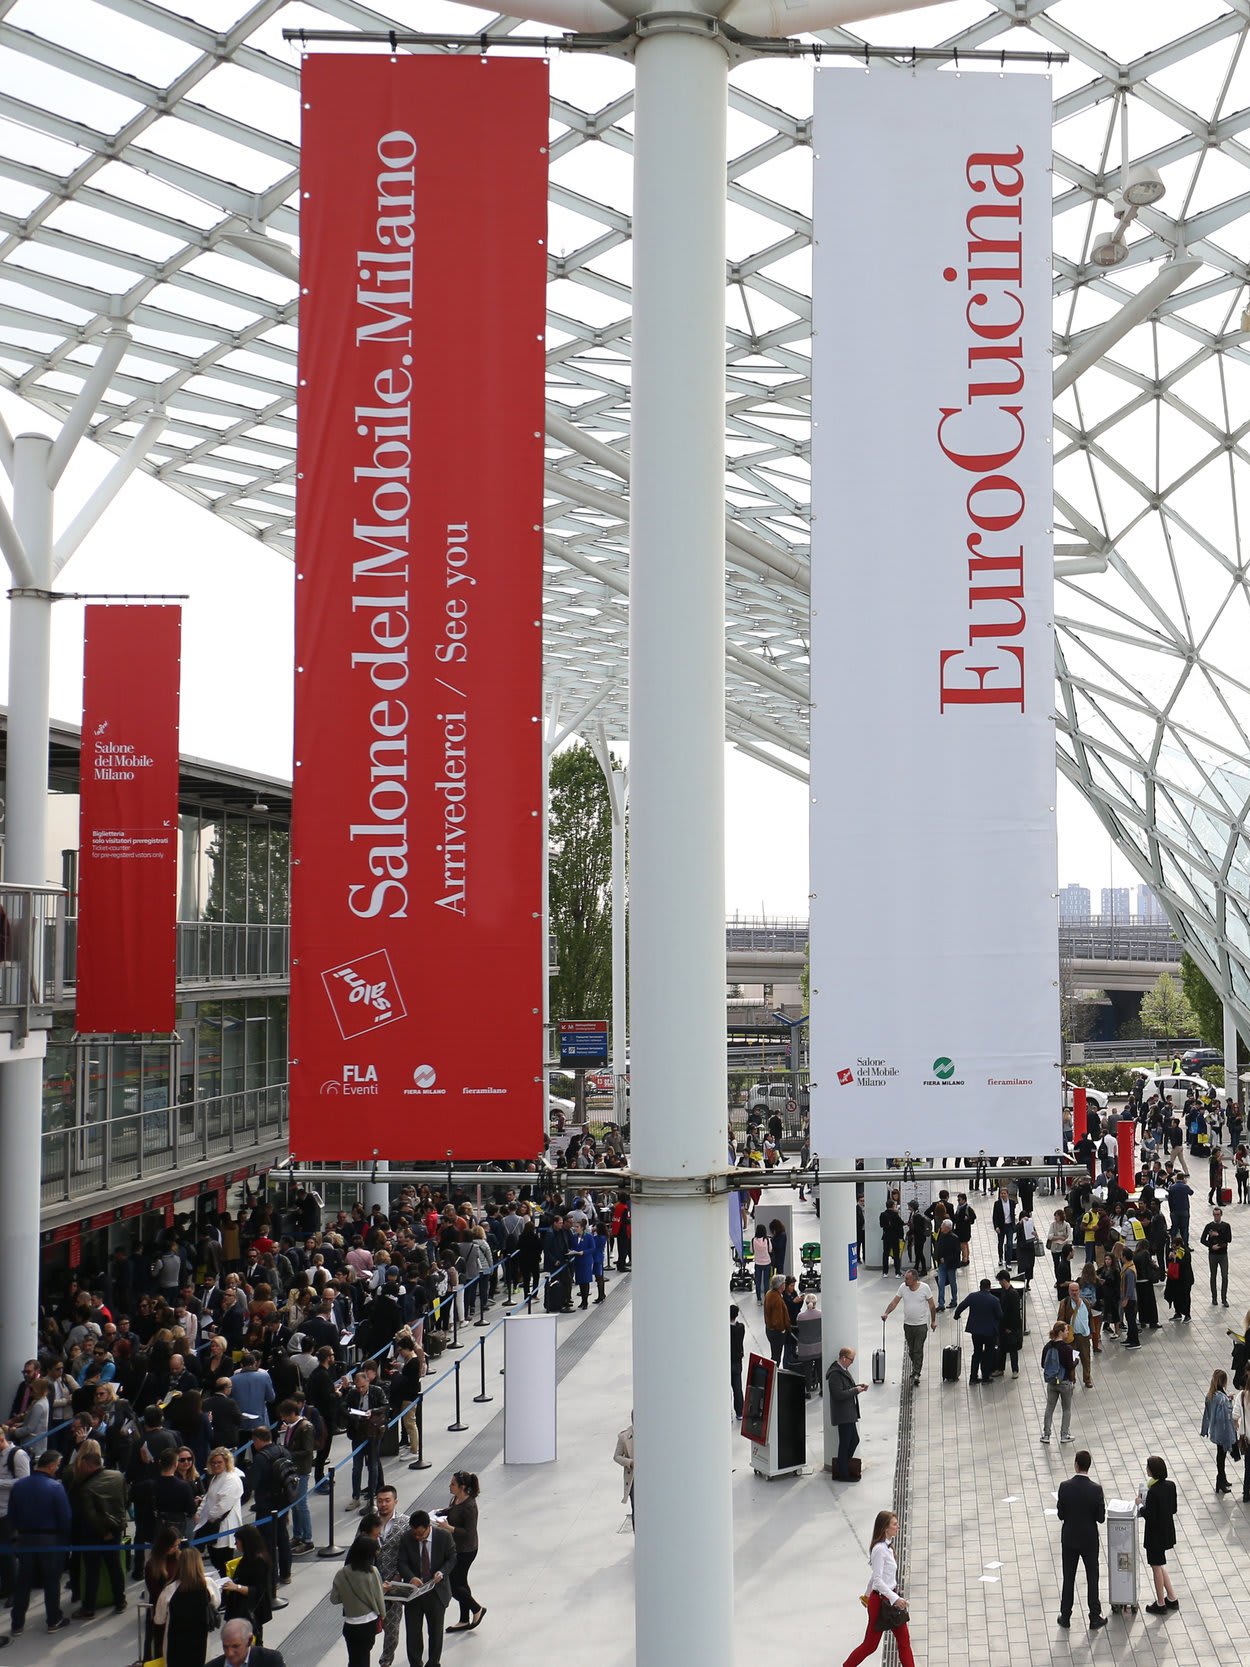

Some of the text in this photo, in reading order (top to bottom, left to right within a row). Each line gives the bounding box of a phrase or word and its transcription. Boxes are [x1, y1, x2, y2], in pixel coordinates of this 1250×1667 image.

[938, 144, 1026, 714] EuroCucina
[447, 522, 476, 587] you
[435, 600, 467, 662] See
[352, 590, 409, 690] del
[95, 742, 134, 753] Salone
[95, 755, 154, 767] del Mobile
[95, 768, 134, 780] Milano
[349, 700, 409, 917] Salone
[435, 712, 466, 916] Arrivederci
[857, 1057, 885, 1066] Salone
[343, 1065, 377, 1081] FLA
[857, 1067, 899, 1076] del Mobile
[857, 1078, 886, 1087] Milano
[987, 1078, 1033, 1086] fieramilano
[343, 1083, 378, 1095] Eventi
[462, 1086, 507, 1094] fieramilano
